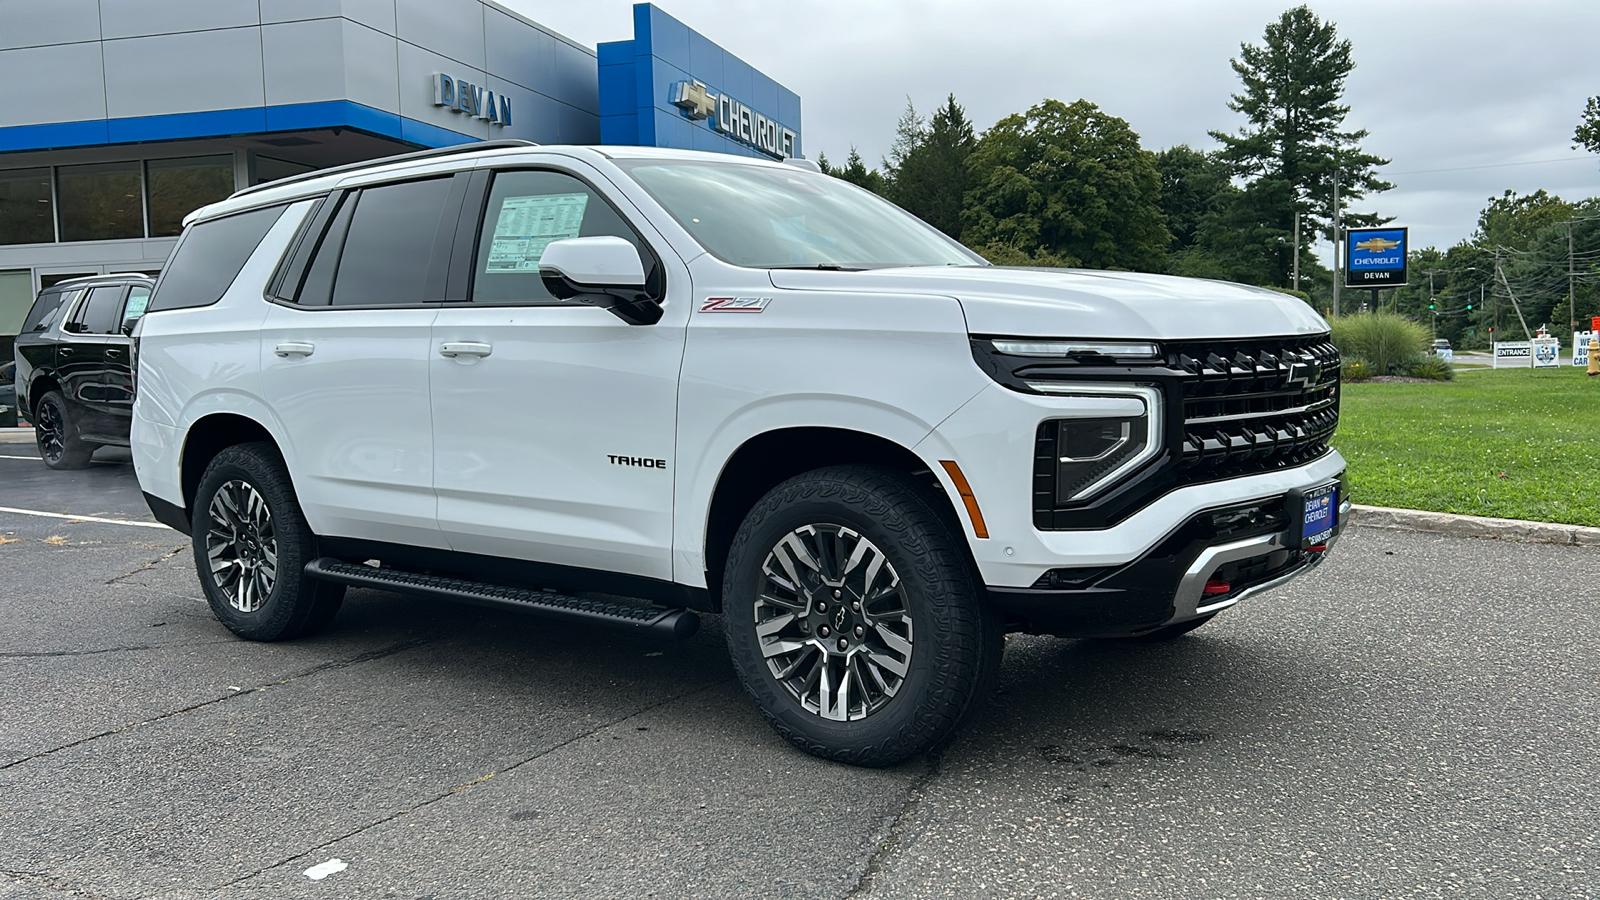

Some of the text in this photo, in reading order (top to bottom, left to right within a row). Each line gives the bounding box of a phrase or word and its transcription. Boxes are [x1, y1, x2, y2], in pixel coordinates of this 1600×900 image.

[434, 73, 512, 126] DEVAN
[715, 93, 797, 159] CHEVROLET
[1354, 257, 1400, 265] CHEVROLET
[698, 297, 772, 313] Z71
[1578, 348, 1588, 356] BU
[1574, 357, 1588, 365] CAR
[607, 454, 666, 469] TAHOE
[1305, 498, 1320, 512] DEVAN
[1304, 507, 1328, 523] CHEVROLET
